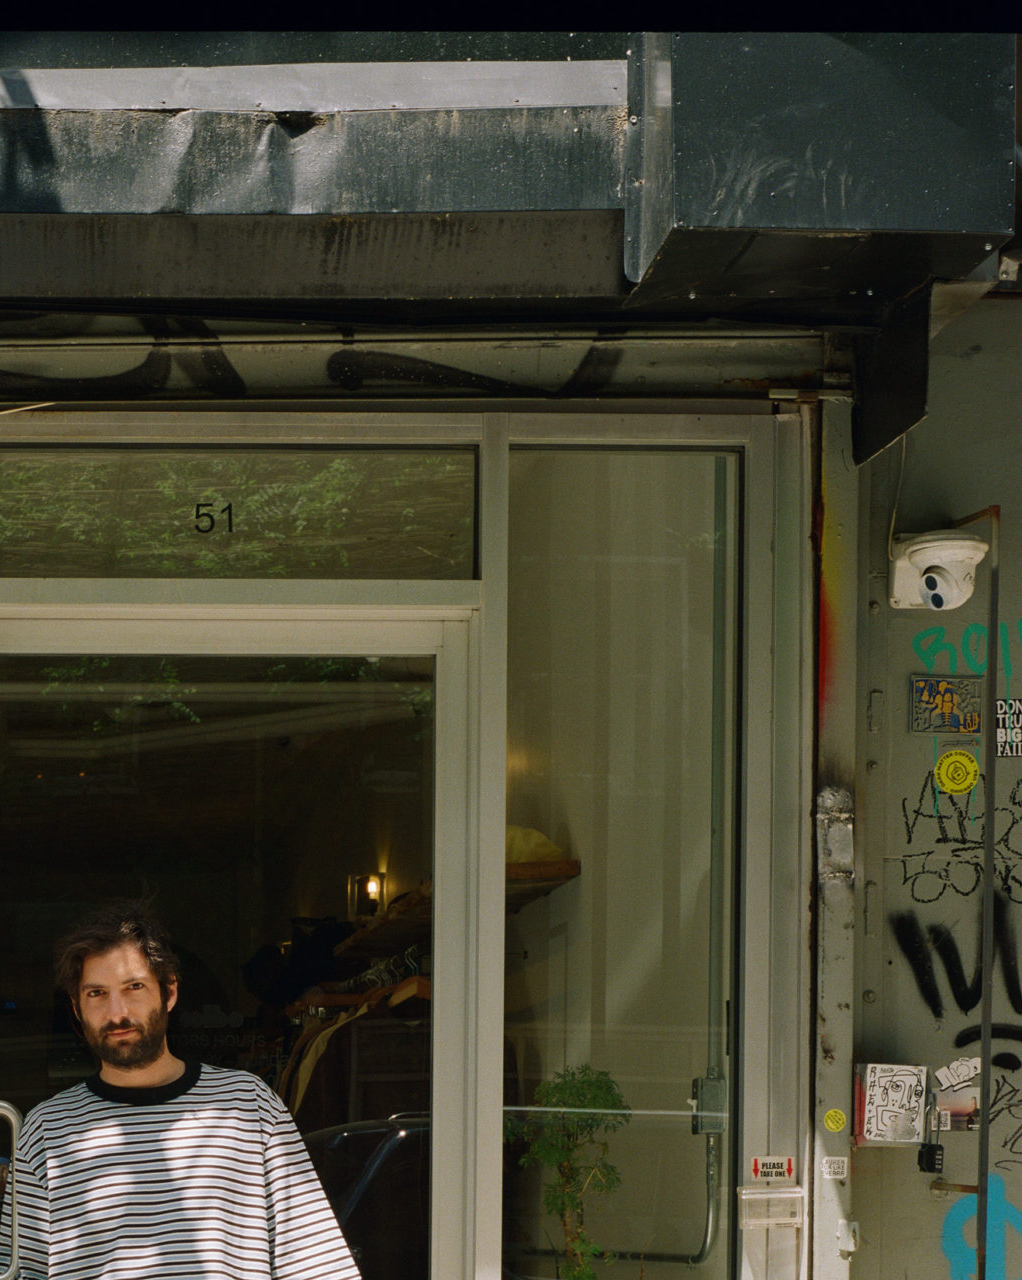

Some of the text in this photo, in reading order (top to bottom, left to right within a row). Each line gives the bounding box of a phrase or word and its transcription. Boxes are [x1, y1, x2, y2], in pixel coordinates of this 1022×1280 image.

[195, 503, 232, 533] 51
[996, 728, 1022, 742] BIG
[760, 1170, 786, 1178] TAKE ONE
